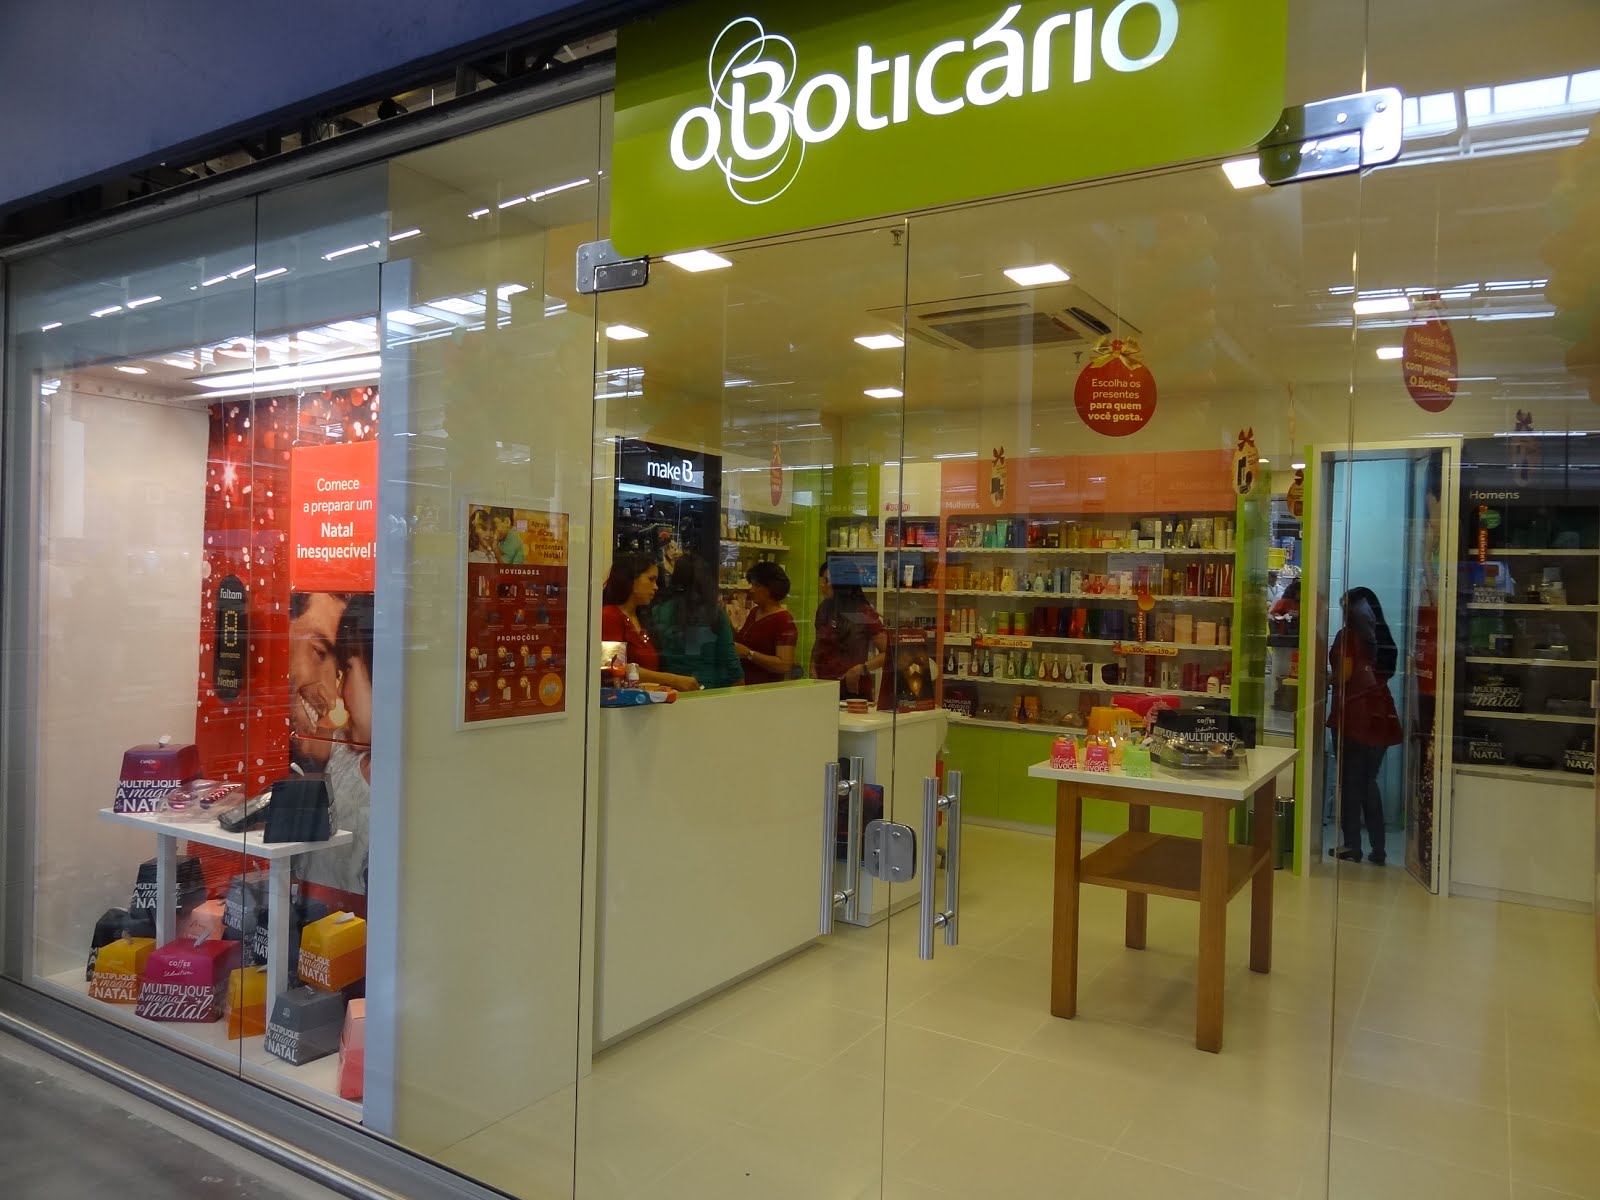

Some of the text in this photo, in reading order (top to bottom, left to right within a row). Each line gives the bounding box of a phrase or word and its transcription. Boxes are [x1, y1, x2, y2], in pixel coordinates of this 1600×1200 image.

[1406, 362, 1422, 372] com
[1092, 379, 1128, 387] Escolha
[1093, 390, 1140, 400] presentes
[1090, 402, 1141, 411] para quem
[1088, 412, 1143, 423] você gosta.
[647, 461, 681, 480] make
[317, 478, 360, 491] Comece
[1470, 490, 1520, 500] Homens
[303, 500, 373, 516] a preparar um
[945, 501, 980, 510] Mulheres
[321, 521, 354, 538] Natal
[297, 542, 371, 562] inesquecível
[500, 567, 540, 576] NOVIDADES
[220, 588, 243, 600] faltam
[496, 633, 540, 642] PROMOÇÕES
[1180, 732, 1235, 743] MULTIPLIQUE
[1473, 751, 1505, 759] NATAL
[1567, 759, 1595, 770] NATA
[118, 780, 182, 788] MULTIPLIQUE
[225, 914, 244, 931] NATA
[92, 971, 137, 981] MULTIPLIQUE
[301, 964, 331, 987] NATAL
[94, 987, 137, 1001] NATAL
[142, 983, 210, 997] MULTIPLIQUE
[267, 1038, 298, 1063] NATAL
